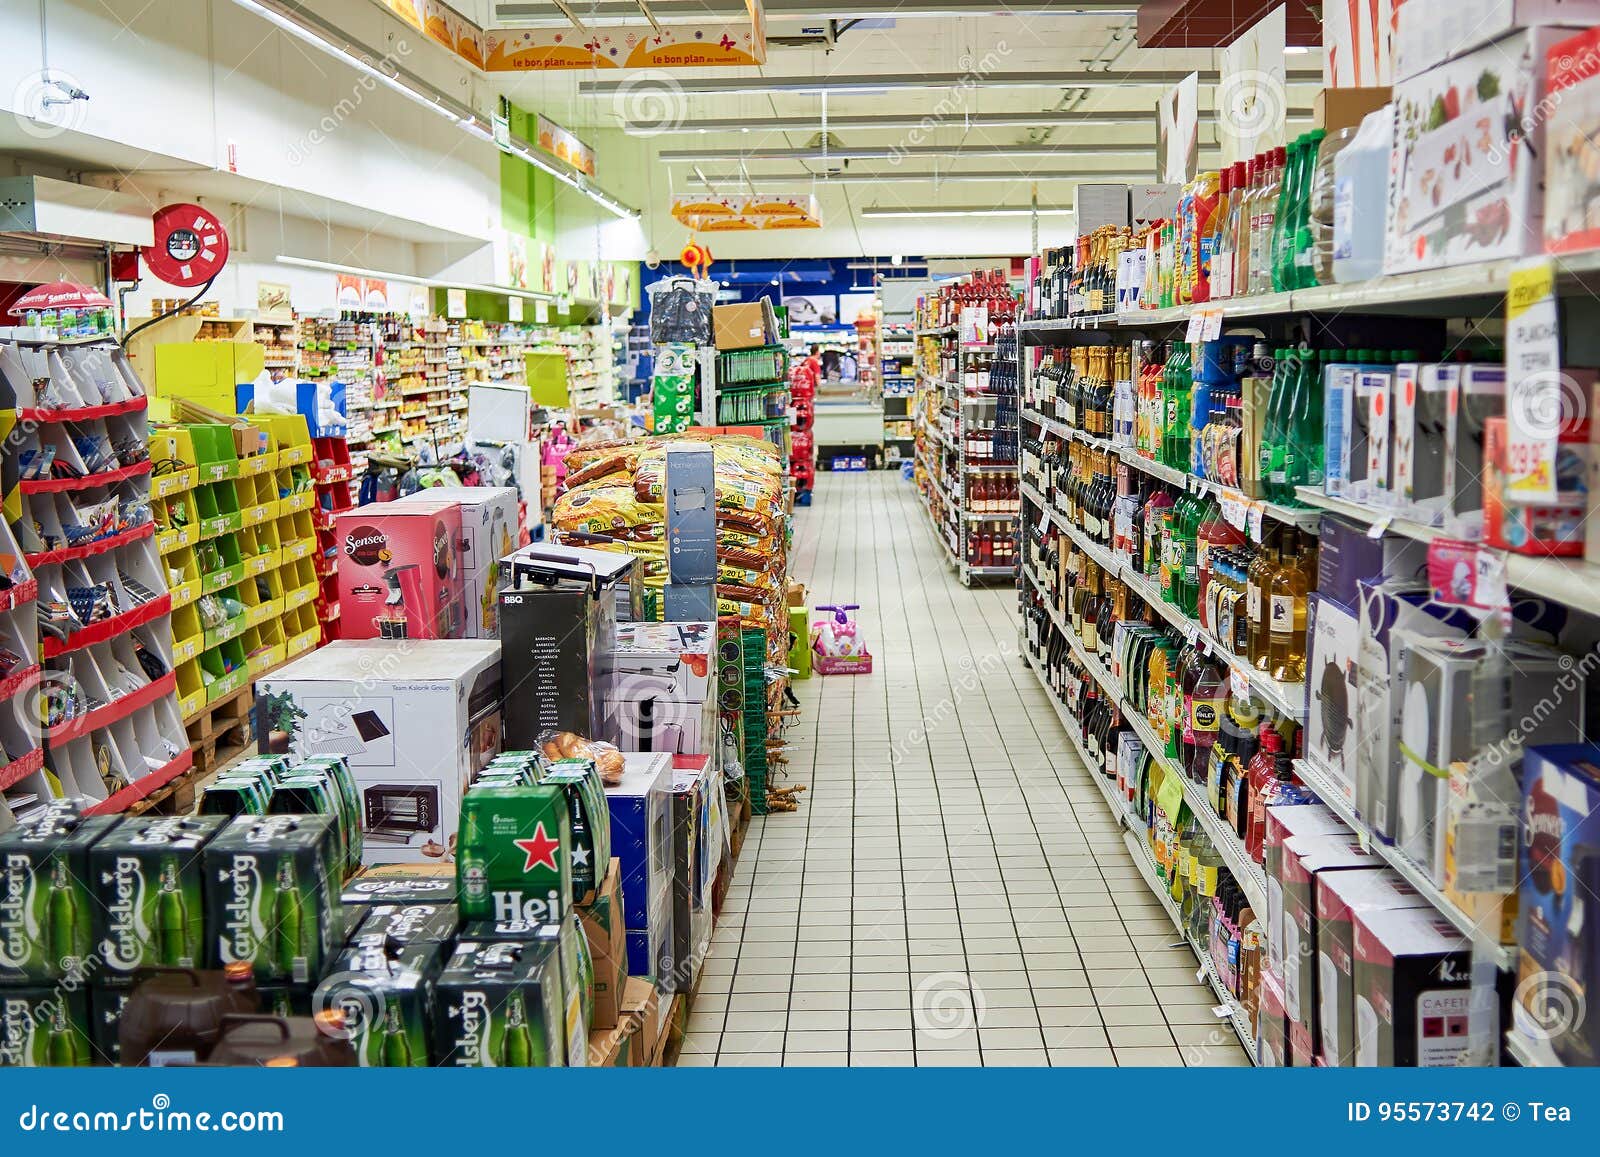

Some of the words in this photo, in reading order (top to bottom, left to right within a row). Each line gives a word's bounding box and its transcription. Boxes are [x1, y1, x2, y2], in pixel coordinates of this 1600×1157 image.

[513, 58, 522, 67] le
[525, 57, 542, 67] bon
[544, 58, 565, 68] plan
[653, 55, 662, 64] le
[664, 55, 682, 64] bon
[684, 55, 705, 65] plan
[726, 494, 736, 502] 20
[344, 533, 389, 555] Senseo
[504, 596, 523, 604] BBQ
[720, 603, 730, 611] 20
[431, 684, 450, 692] Group
[0, 854, 39, 968] Carlsberg
[219, 855, 267, 963] Carlsberg
[491, 889, 559, 920] Hei
[103, 857, 149, 970] Carlsberg
[455, 990, 491, 1066] lsberg
